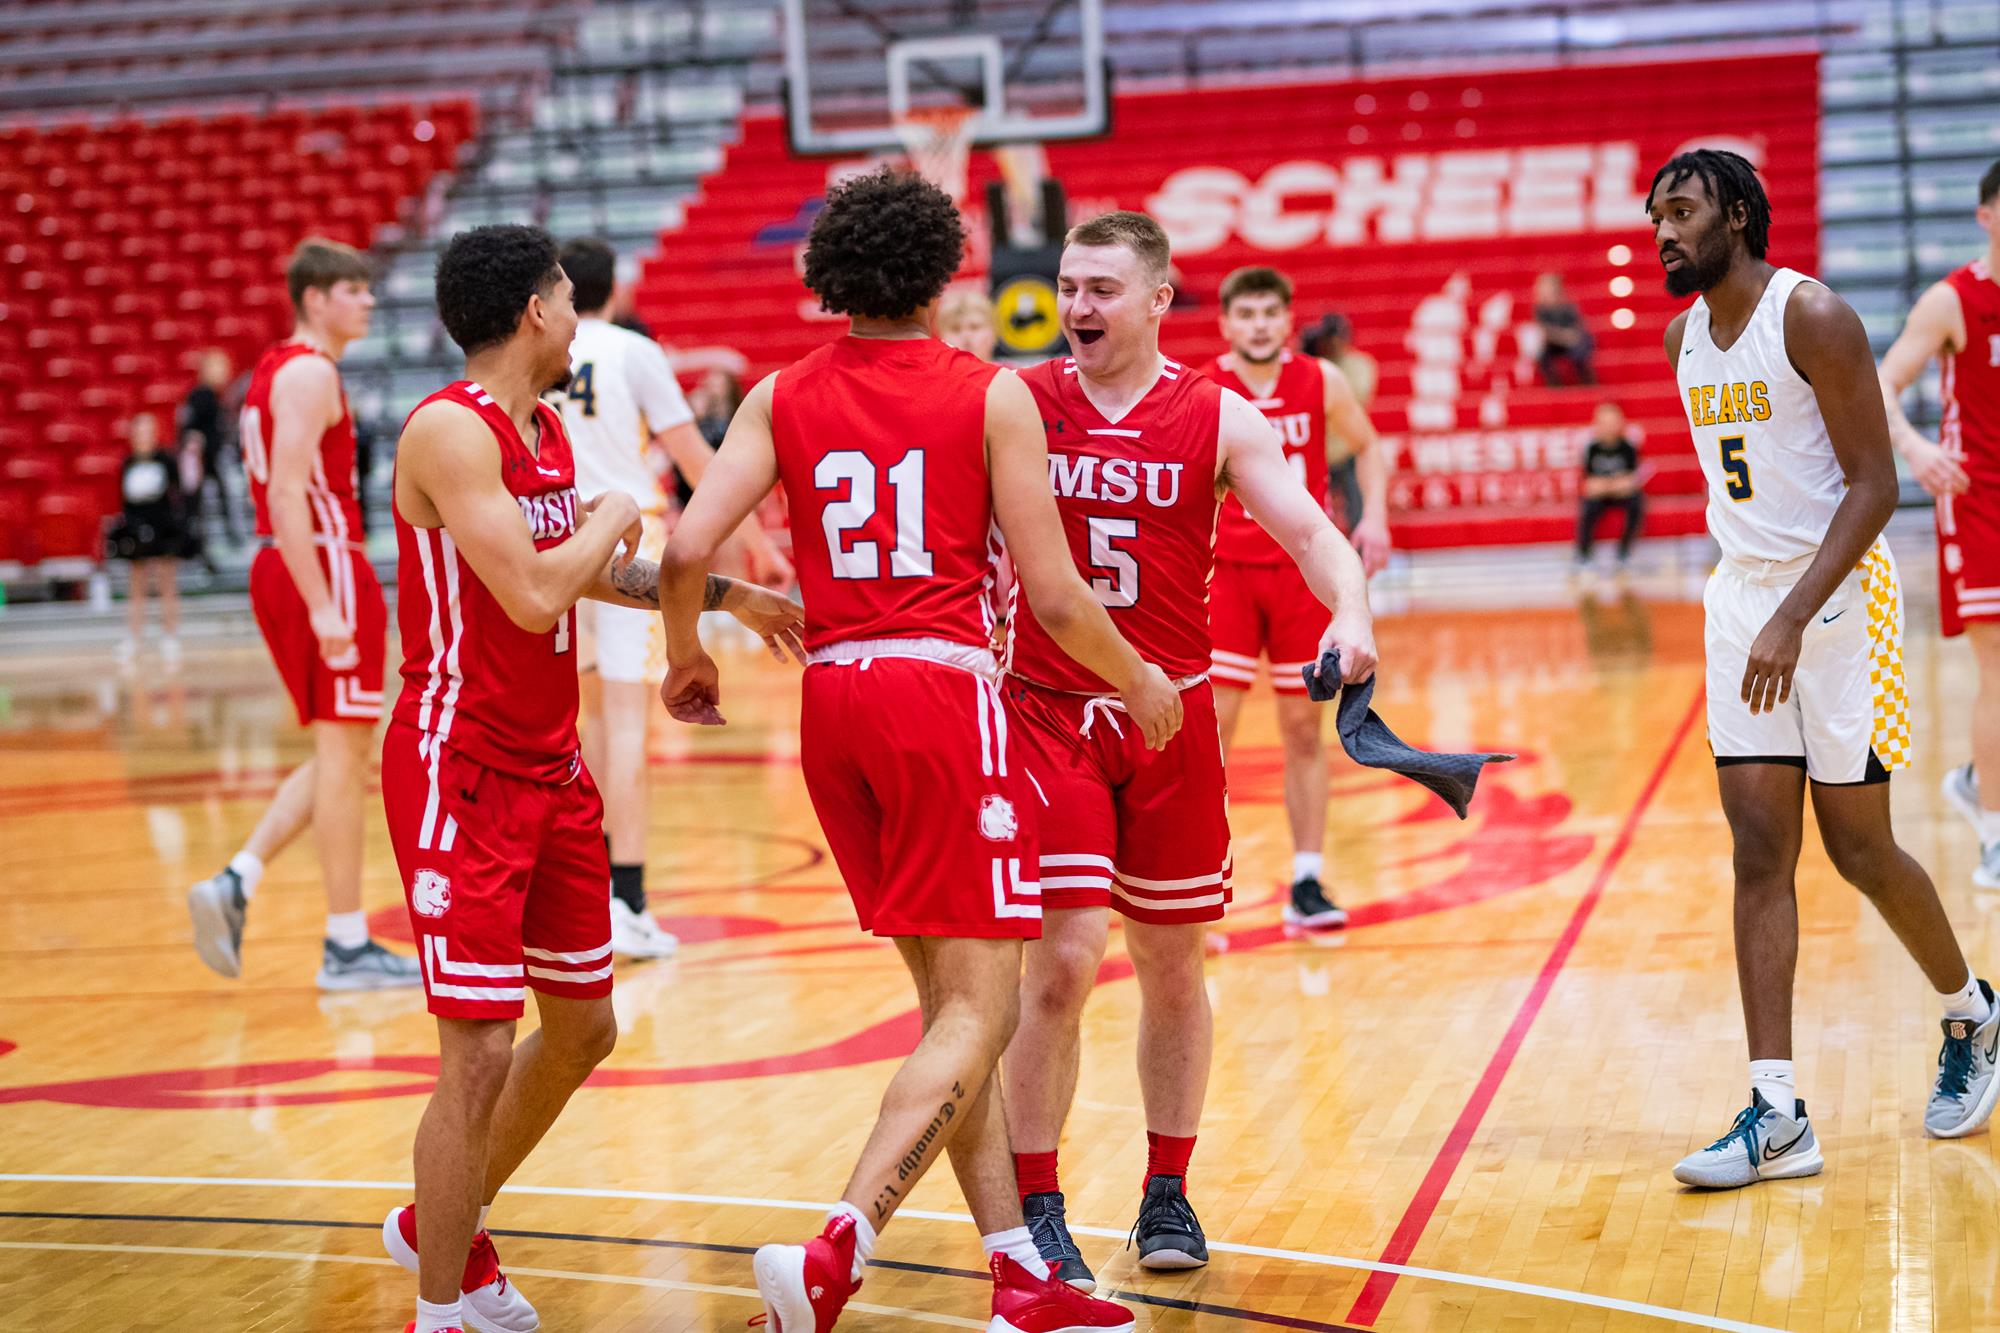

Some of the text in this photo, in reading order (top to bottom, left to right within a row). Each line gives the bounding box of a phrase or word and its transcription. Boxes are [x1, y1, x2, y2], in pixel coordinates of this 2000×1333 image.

[1688, 381, 1772, 427] BEARS
[1047, 453, 1184, 508] MSU
[1718, 434, 1754, 503] 5
[813, 448, 935, 581] 21
[1086, 516, 1140, 610] 5
[873, 1080, 965, 1221] 2 Timothy 1:7
